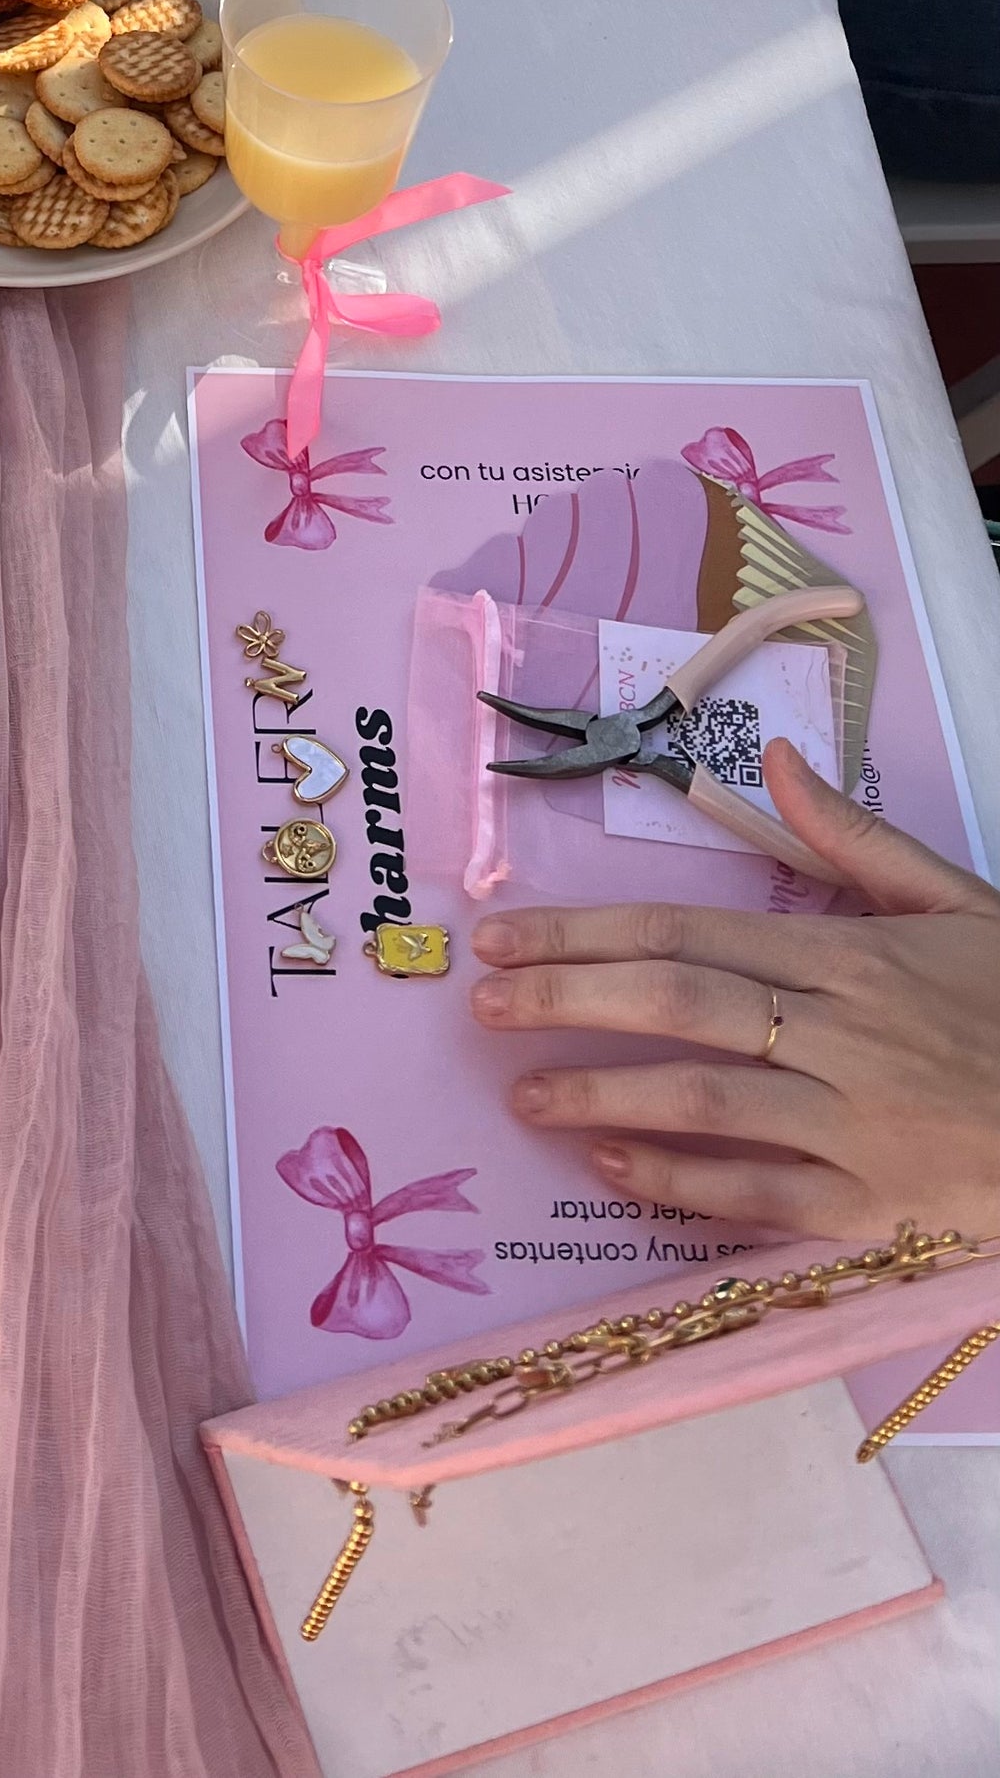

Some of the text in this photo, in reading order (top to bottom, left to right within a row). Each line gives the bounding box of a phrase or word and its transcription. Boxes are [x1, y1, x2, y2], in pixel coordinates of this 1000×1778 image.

[420, 464, 471, 481] con
[477, 462, 505, 481] tu
[355, 705, 413, 979] harms
[550, 1200, 642, 1223] contar
[494, 1240, 639, 1265] contentas
[647, 1235, 708, 1262] muy
